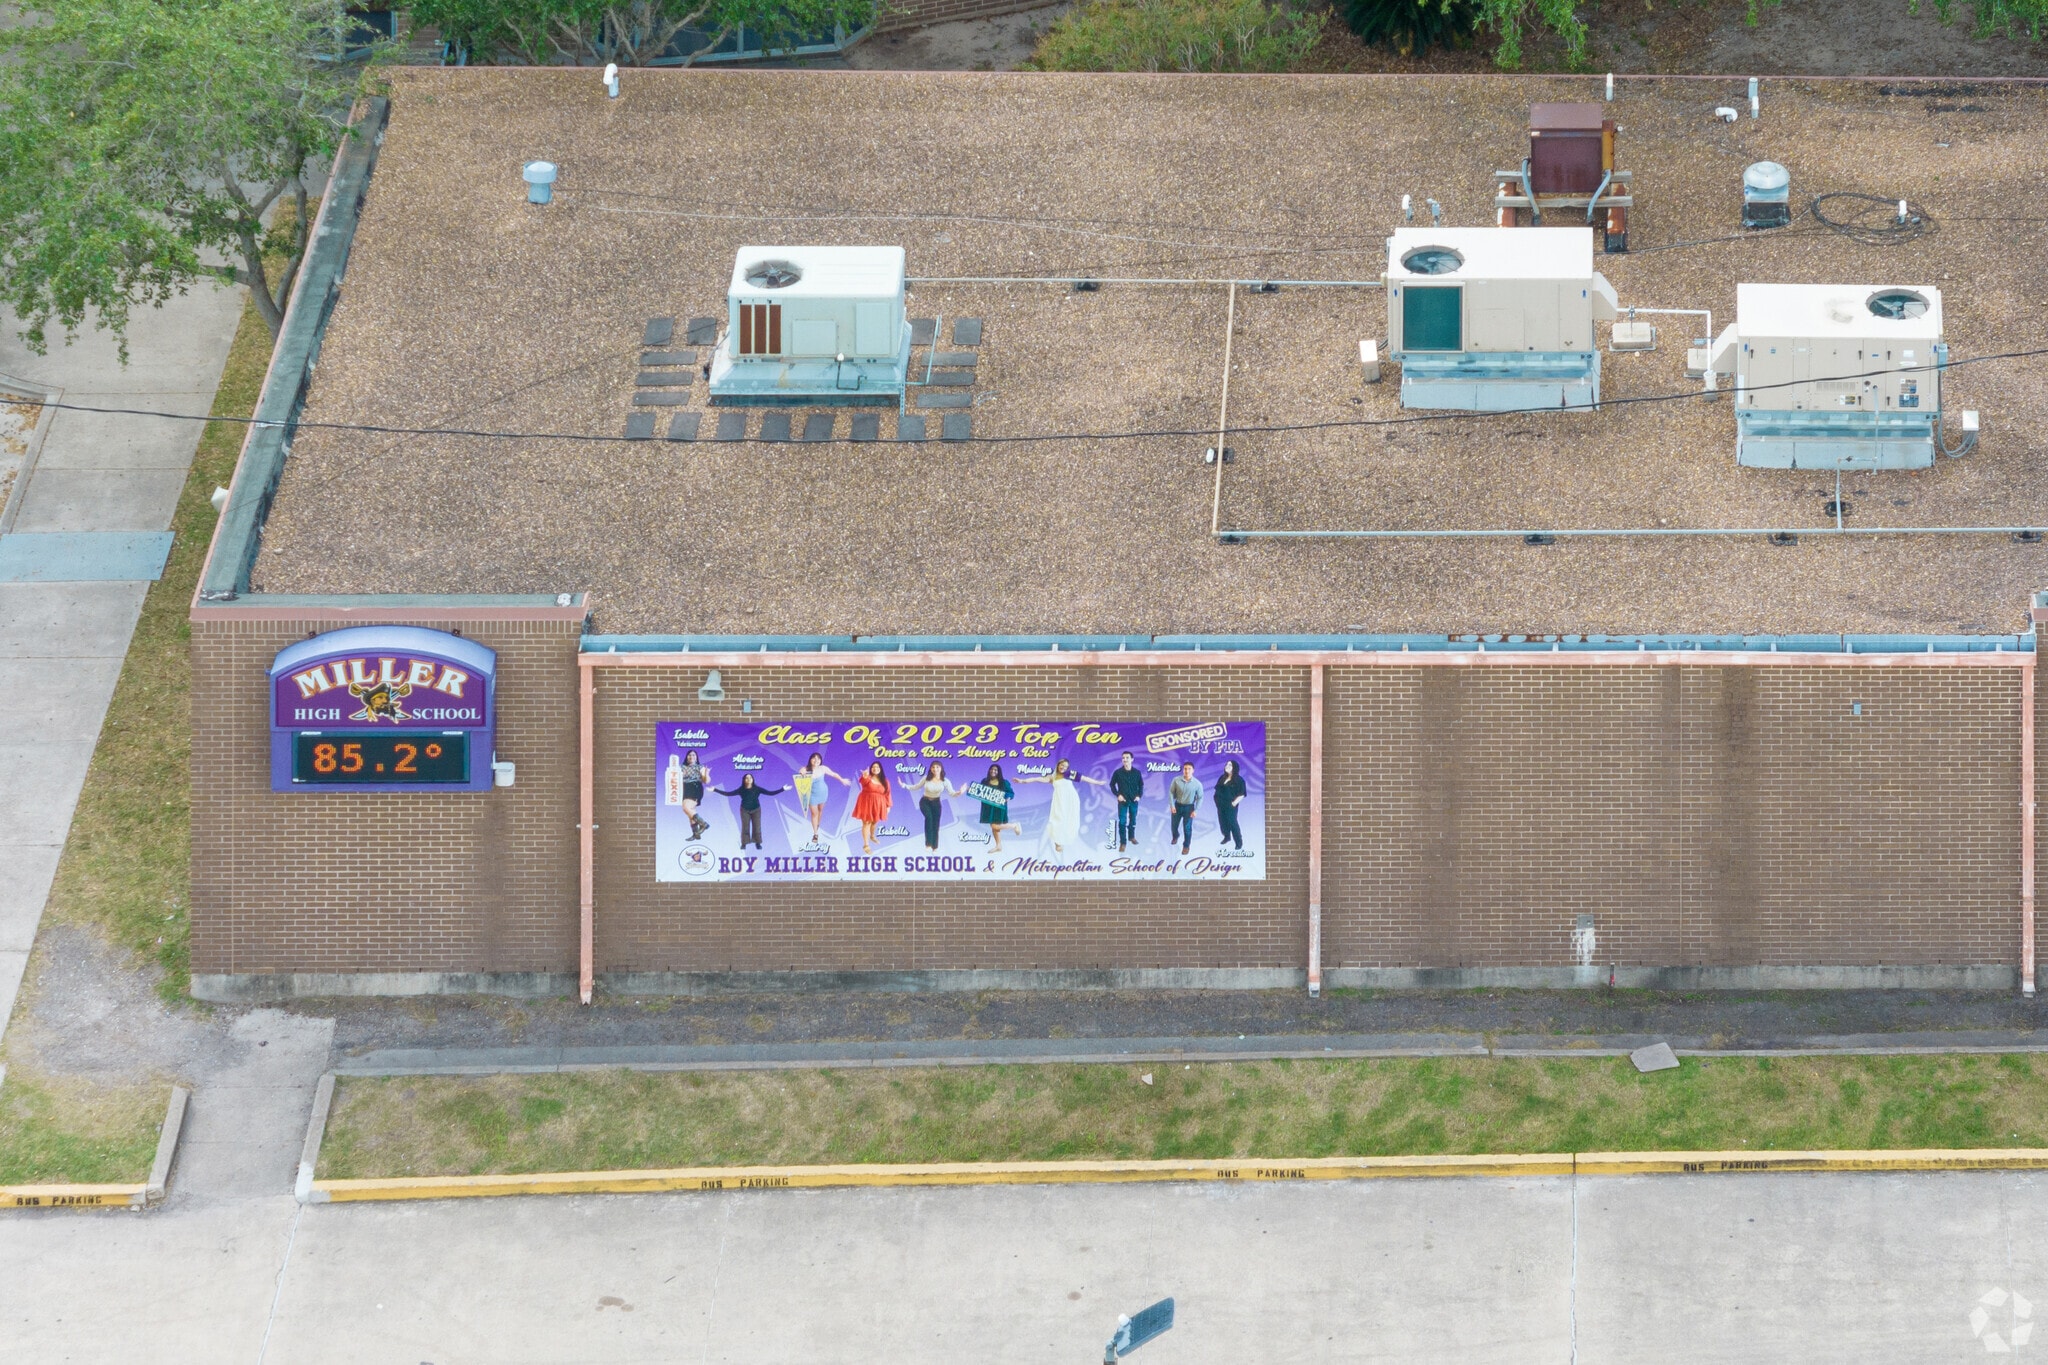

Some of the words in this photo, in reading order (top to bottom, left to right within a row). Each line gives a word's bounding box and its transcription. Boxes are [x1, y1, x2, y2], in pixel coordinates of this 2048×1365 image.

[292, 657, 469, 699] MILLER
[294, 708, 341, 720] HIGH
[412, 707, 481, 720] SCHOOL
[673, 728, 710, 740] Isabella
[758, 725, 832, 744] Class
[843, 725, 881, 748] Of
[891, 724, 999, 744] 2023
[1011, 724, 1062, 747] Top
[1072, 724, 1122, 744] Ten
[1151, 725, 1224, 749] SPONSORED
[908, 750, 917, 758] a
[958, 745, 1006, 761] Always
[1009, 750, 1018, 758] a
[1189, 739, 1211, 754] BY
[1213, 739, 1244, 754] PTA
[895, 763, 926, 776] Beverly
[967, 787, 1006, 805] ISLANDER
[970, 781, 1006, 798] #FUTURE
[877, 825, 909, 837] Isabella
[718, 856, 758, 873] ROY
[764, 856, 839, 873] MILLER
[846, 856, 898, 873] HIGH
[904, 856, 975, 873] SCHOOL
[983, 859, 995, 873] &
[1001, 856, 1103, 879] Metropolitan
[1109, 857, 1165, 874] School
[1166, 859, 1182, 875] of
[1184, 857, 1243, 878] Design
[1721, 1160, 1768, 1170] PARKING
[1257, 1168, 1305, 1178] PARKING
[740, 1177, 789, 1188] PARKING
[52, 1195, 102, 1205] PARKING
